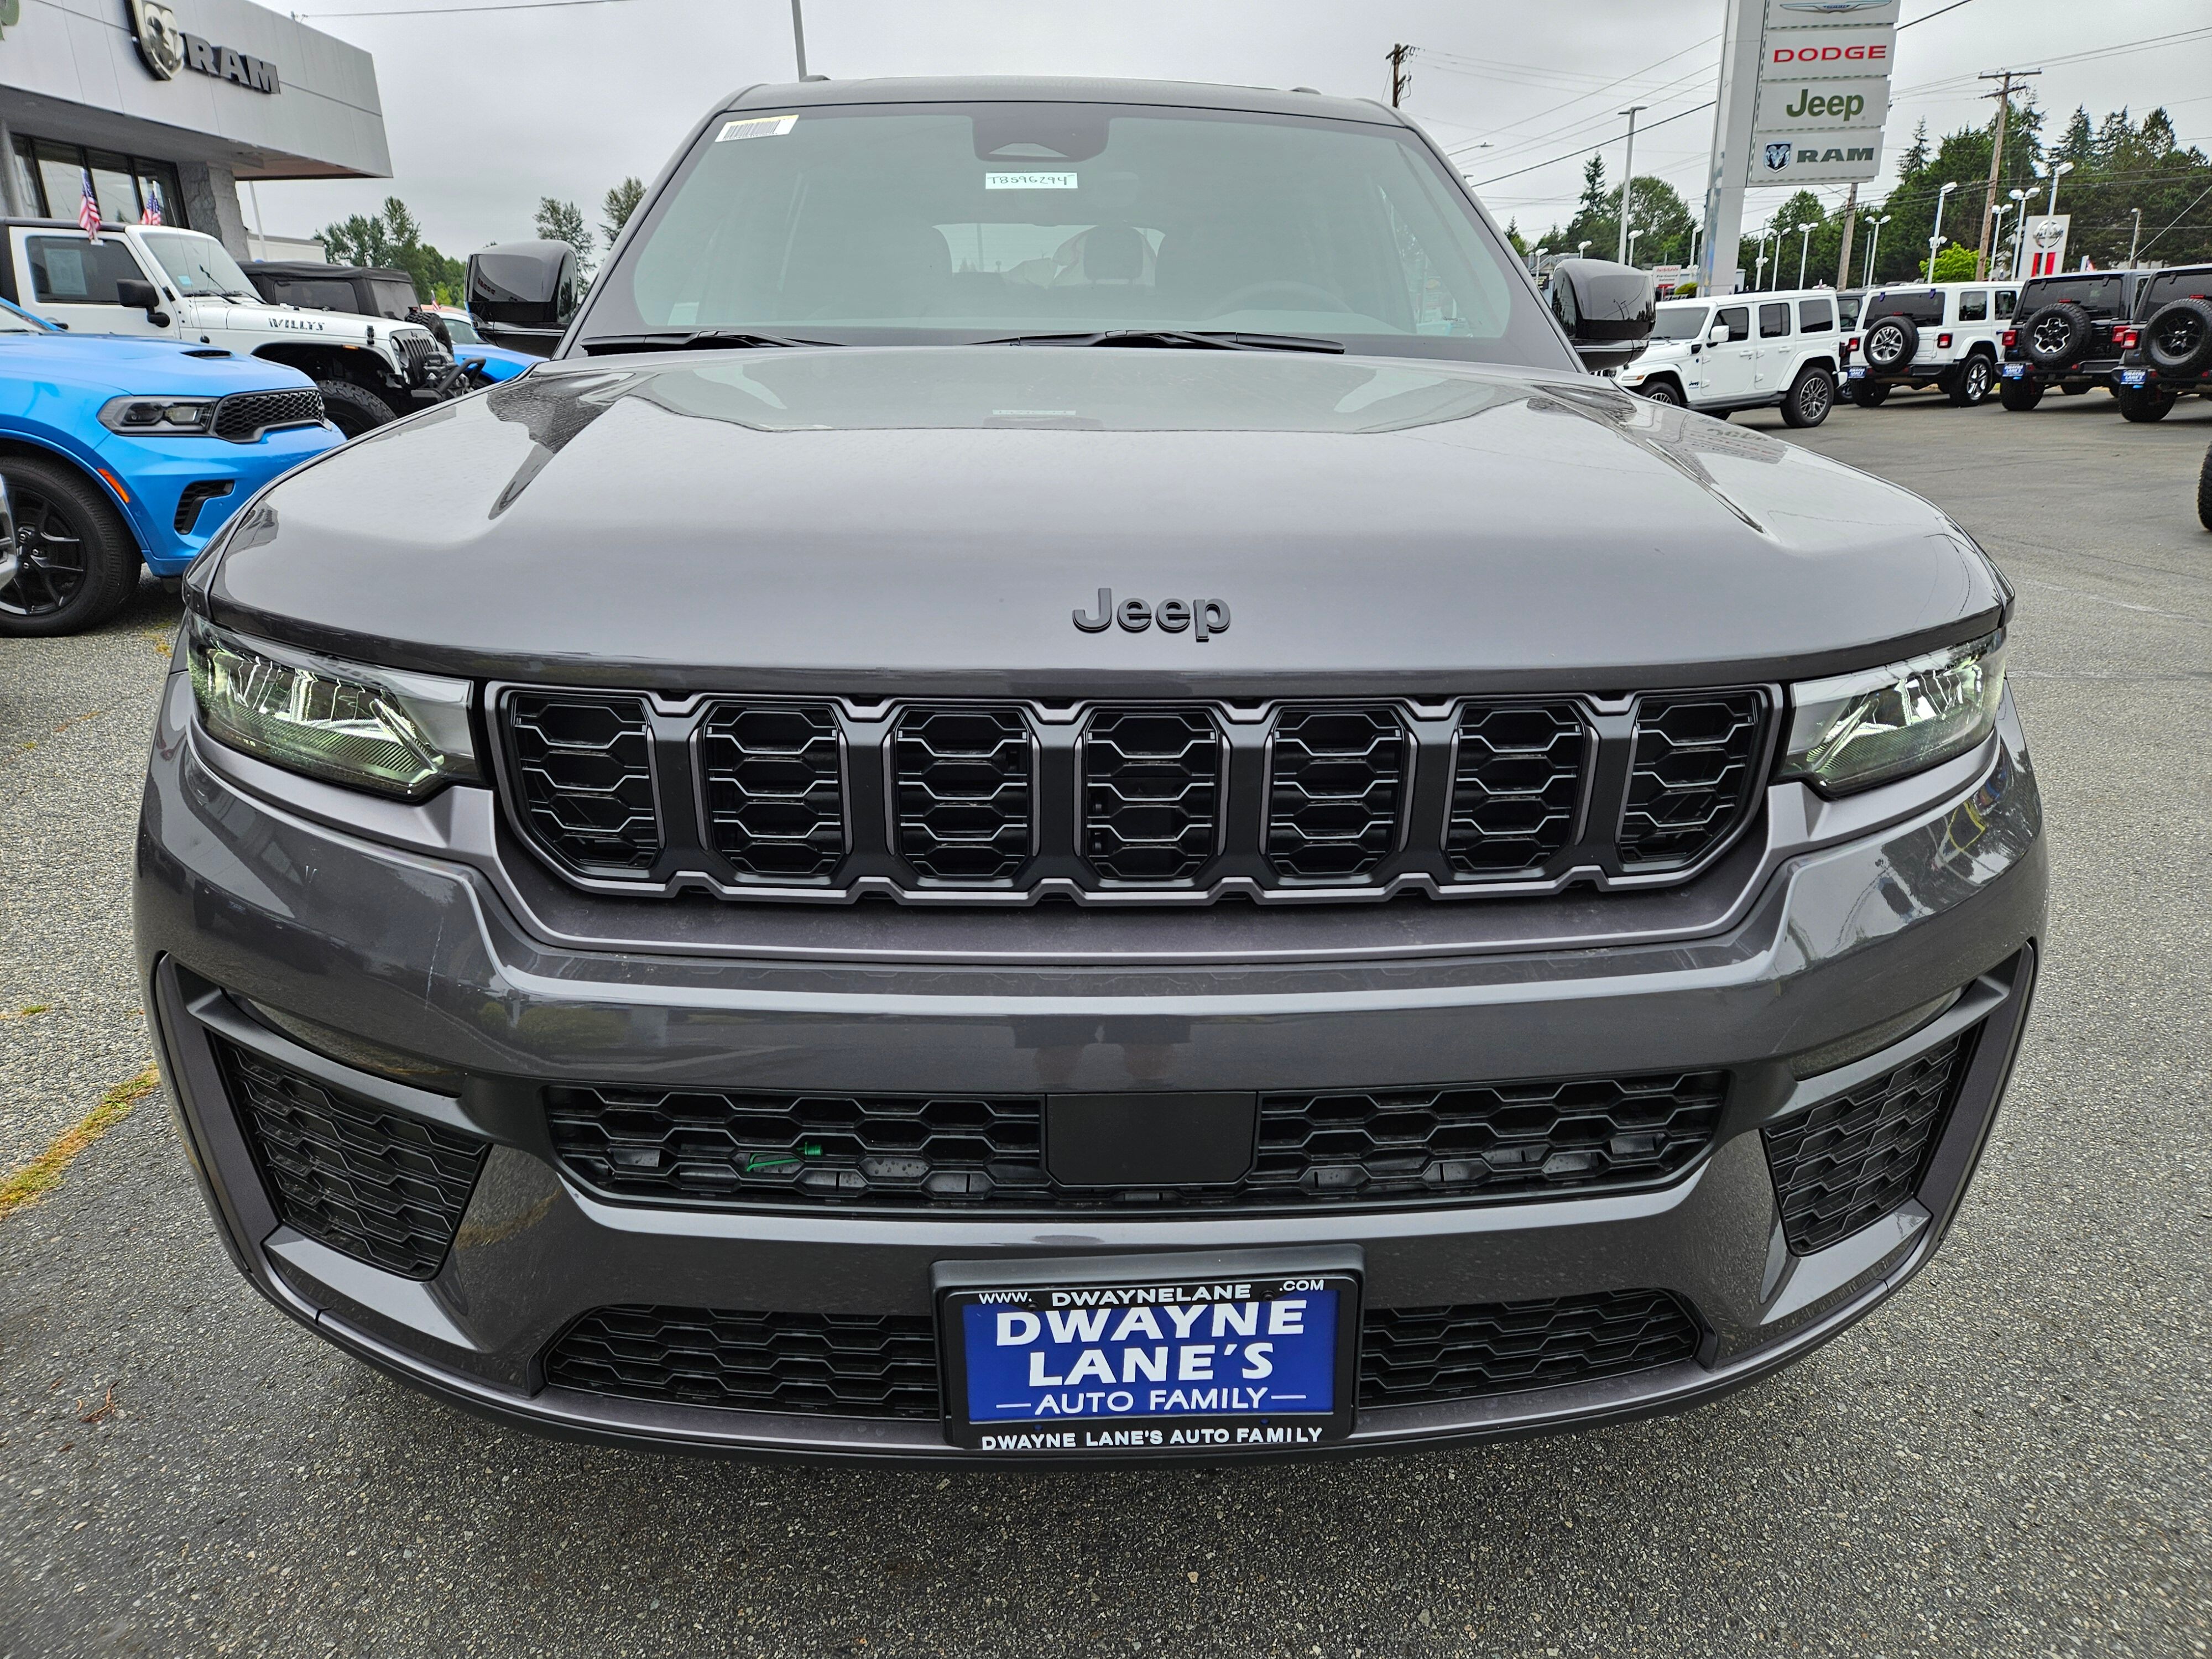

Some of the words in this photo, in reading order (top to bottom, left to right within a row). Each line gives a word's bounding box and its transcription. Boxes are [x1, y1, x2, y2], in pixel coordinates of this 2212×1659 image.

[184, 33, 280, 95] RAM
[1773, 45, 1887, 63] DODGE
[1786, 88, 1864, 122] Jeep
[1797, 148, 1874, 163] RAM
[268, 317, 325, 331] WILLYS
[1072, 587, 1230, 643] Jeep
[1052, 1284, 1251, 1307] DWAYNELANE
[1279, 1280, 1324, 1292] .COM
[997, 1300, 1307, 1346] DWAYNE
[1029, 1343, 1274, 1387] LANE'S
[1035, 1391, 1134, 1415] AUTO
[1150, 1387, 1269, 1411] FAMILY
[982, 1432, 1076, 1450] DWAYNE
[1086, 1430, 1162, 1447] LANE'S
[1170, 1428, 1230, 1443] AUTO
[1236, 1427, 1323, 1443] FAMILY
